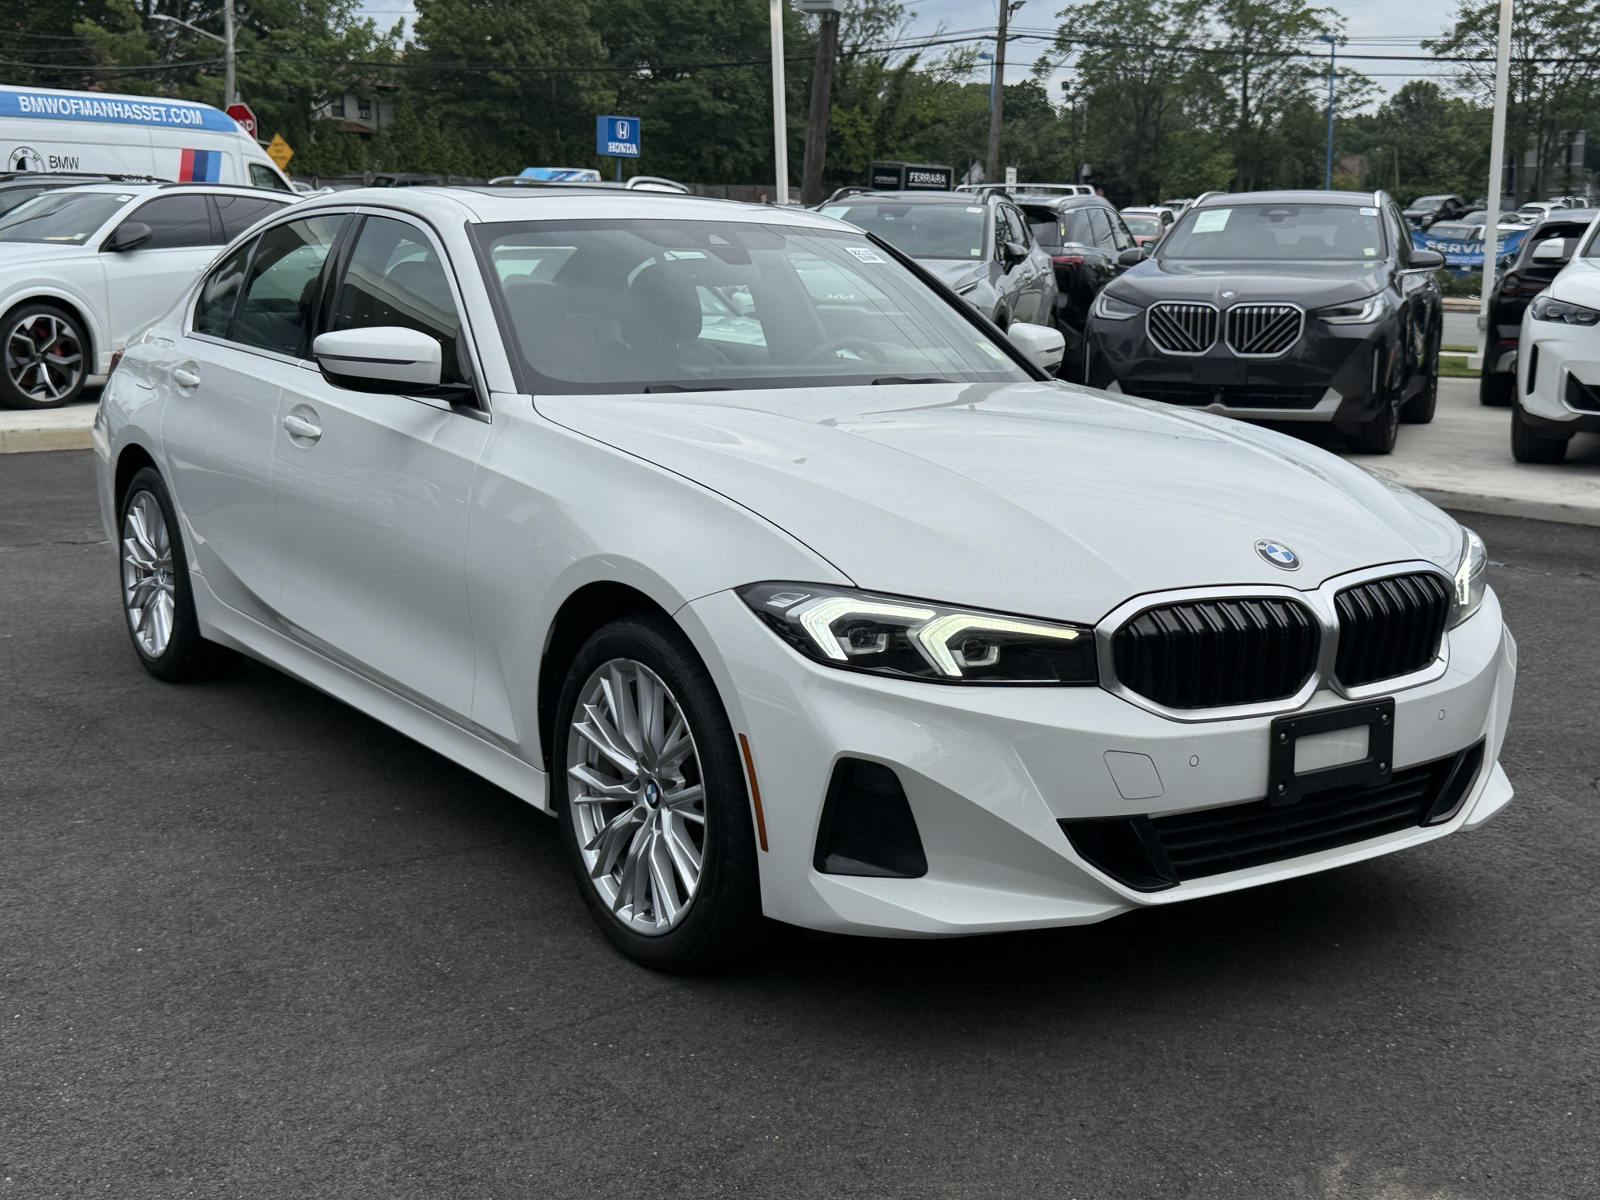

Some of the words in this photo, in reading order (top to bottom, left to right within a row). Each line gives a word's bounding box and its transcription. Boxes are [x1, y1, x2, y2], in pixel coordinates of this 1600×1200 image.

[17, 95, 204, 126] BMWOFMANHASSET.COM
[607, 142, 639, 155] HONDA
[48, 154, 80, 170] BMW
